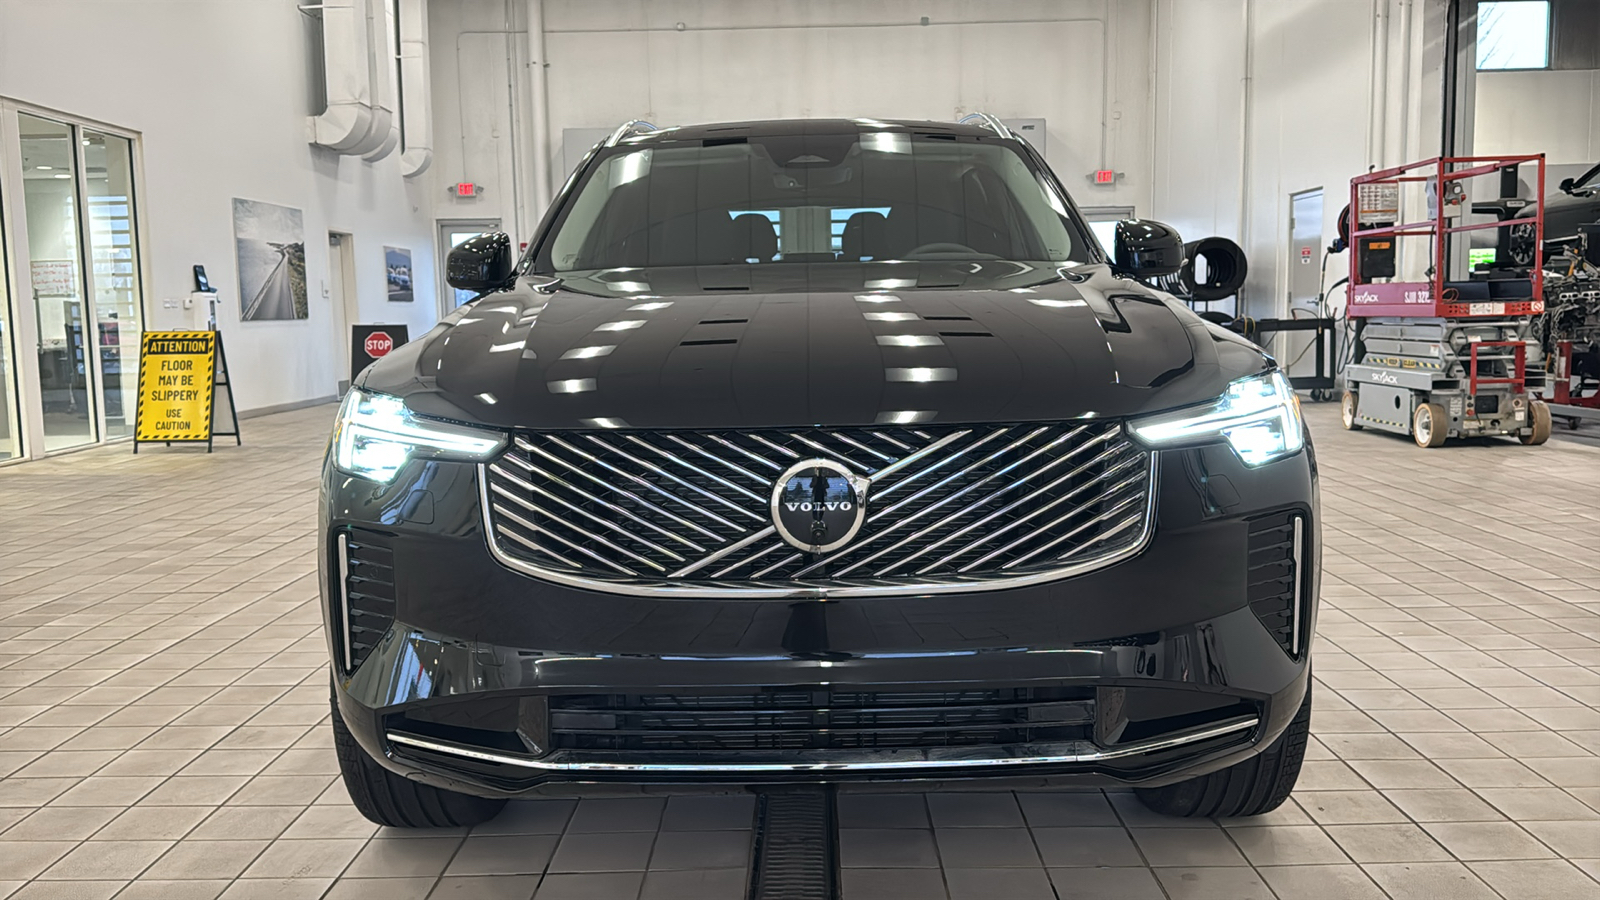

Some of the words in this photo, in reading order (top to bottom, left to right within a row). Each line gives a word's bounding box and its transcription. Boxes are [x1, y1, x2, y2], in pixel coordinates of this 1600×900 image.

[150, 340, 206, 352] ATTENTION
[367, 340, 391, 350] STOP
[161, 360, 193, 371] FLOOR
[158, 375, 178, 386] MAY
[181, 375, 194, 386] BE
[151, 390, 199, 401] SLIPPERY
[166, 409, 182, 418] USE
[155, 421, 191, 431] CAUTION
[785, 501, 852, 512] VOLVO
